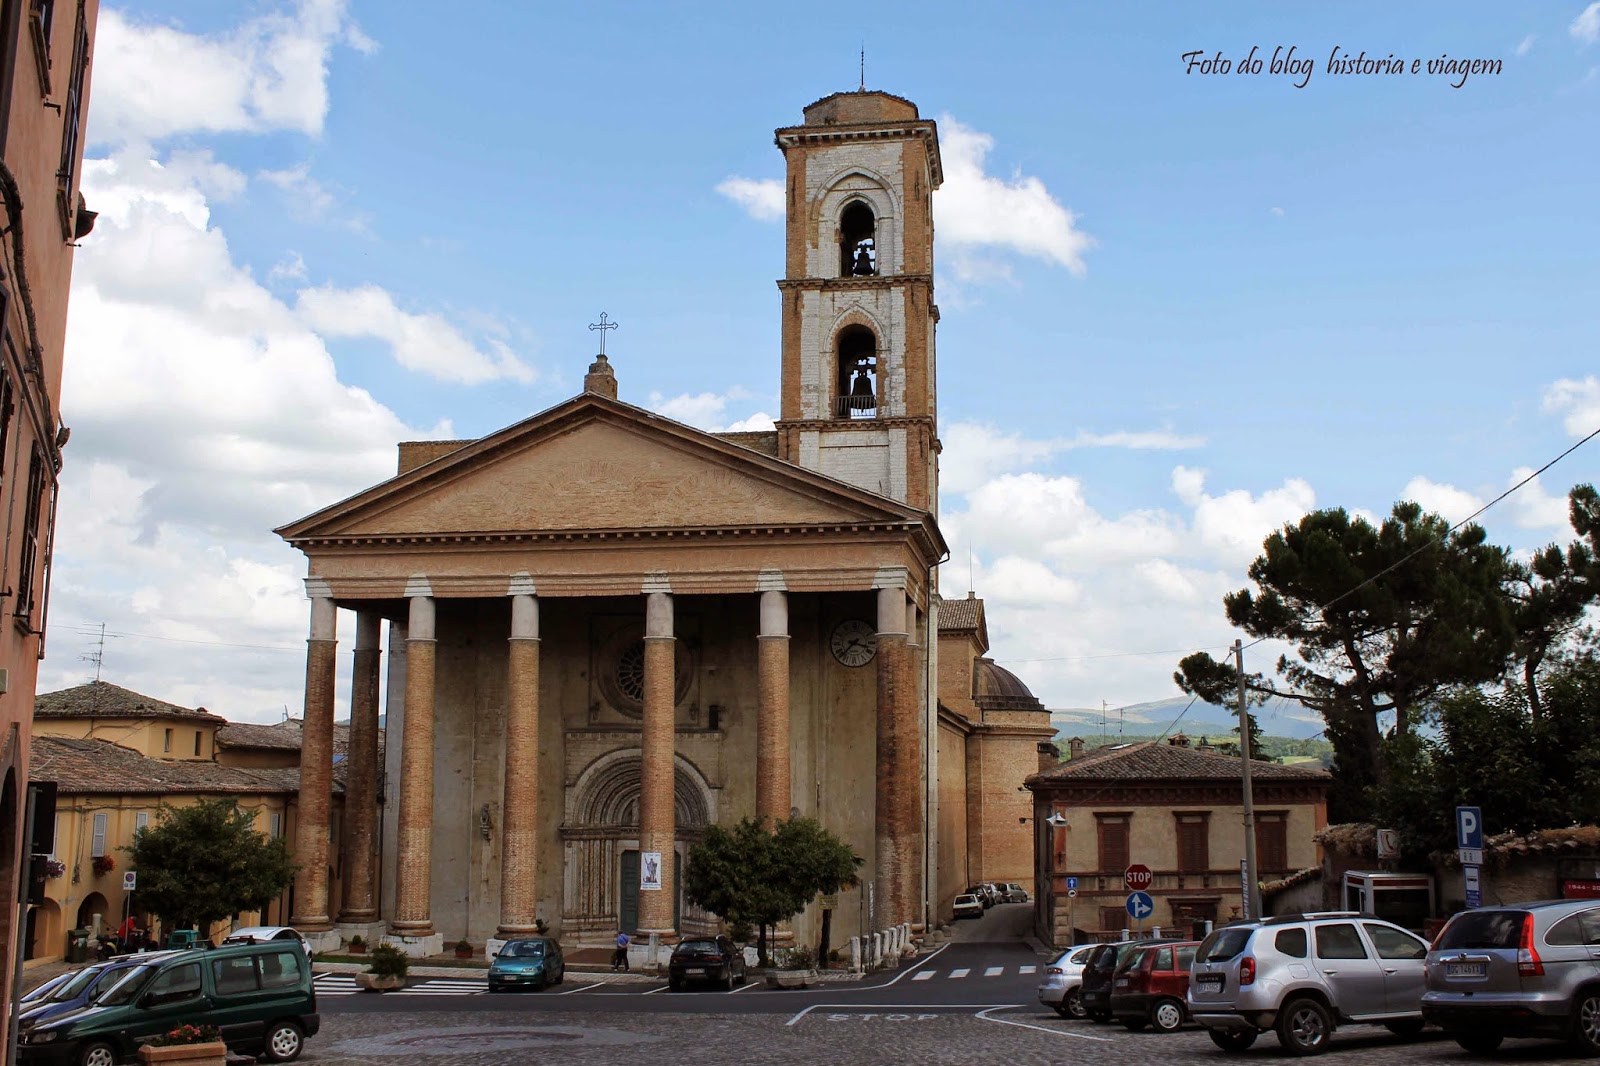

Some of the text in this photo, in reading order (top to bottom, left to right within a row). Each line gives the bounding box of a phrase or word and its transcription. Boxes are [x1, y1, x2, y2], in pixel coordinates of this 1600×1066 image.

[1461, 811, 1477, 845] P
[1126, 872, 1151, 883] STOP
[827, 1014, 939, 1022] STOP
